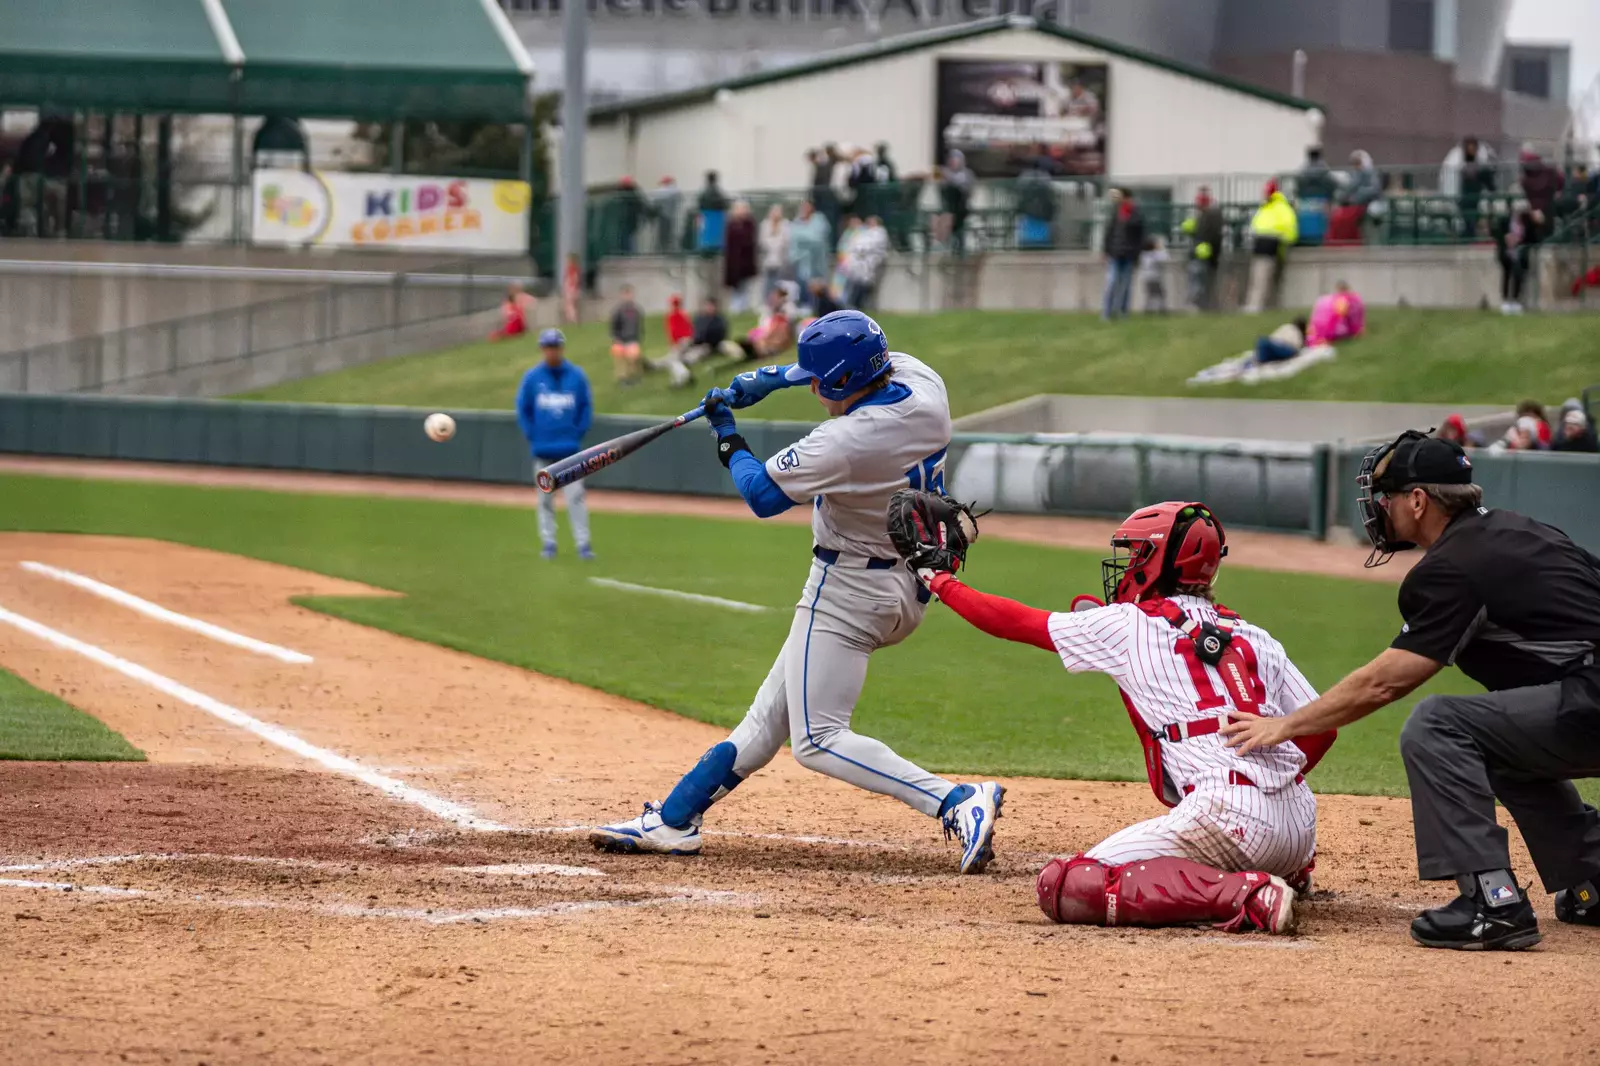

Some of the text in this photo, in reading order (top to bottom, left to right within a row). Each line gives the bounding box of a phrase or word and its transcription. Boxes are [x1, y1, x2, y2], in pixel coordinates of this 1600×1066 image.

[365, 181, 468, 217] KIDS
[870, 353, 884, 372] 15
[1227, 662, 1253, 703] marucci
